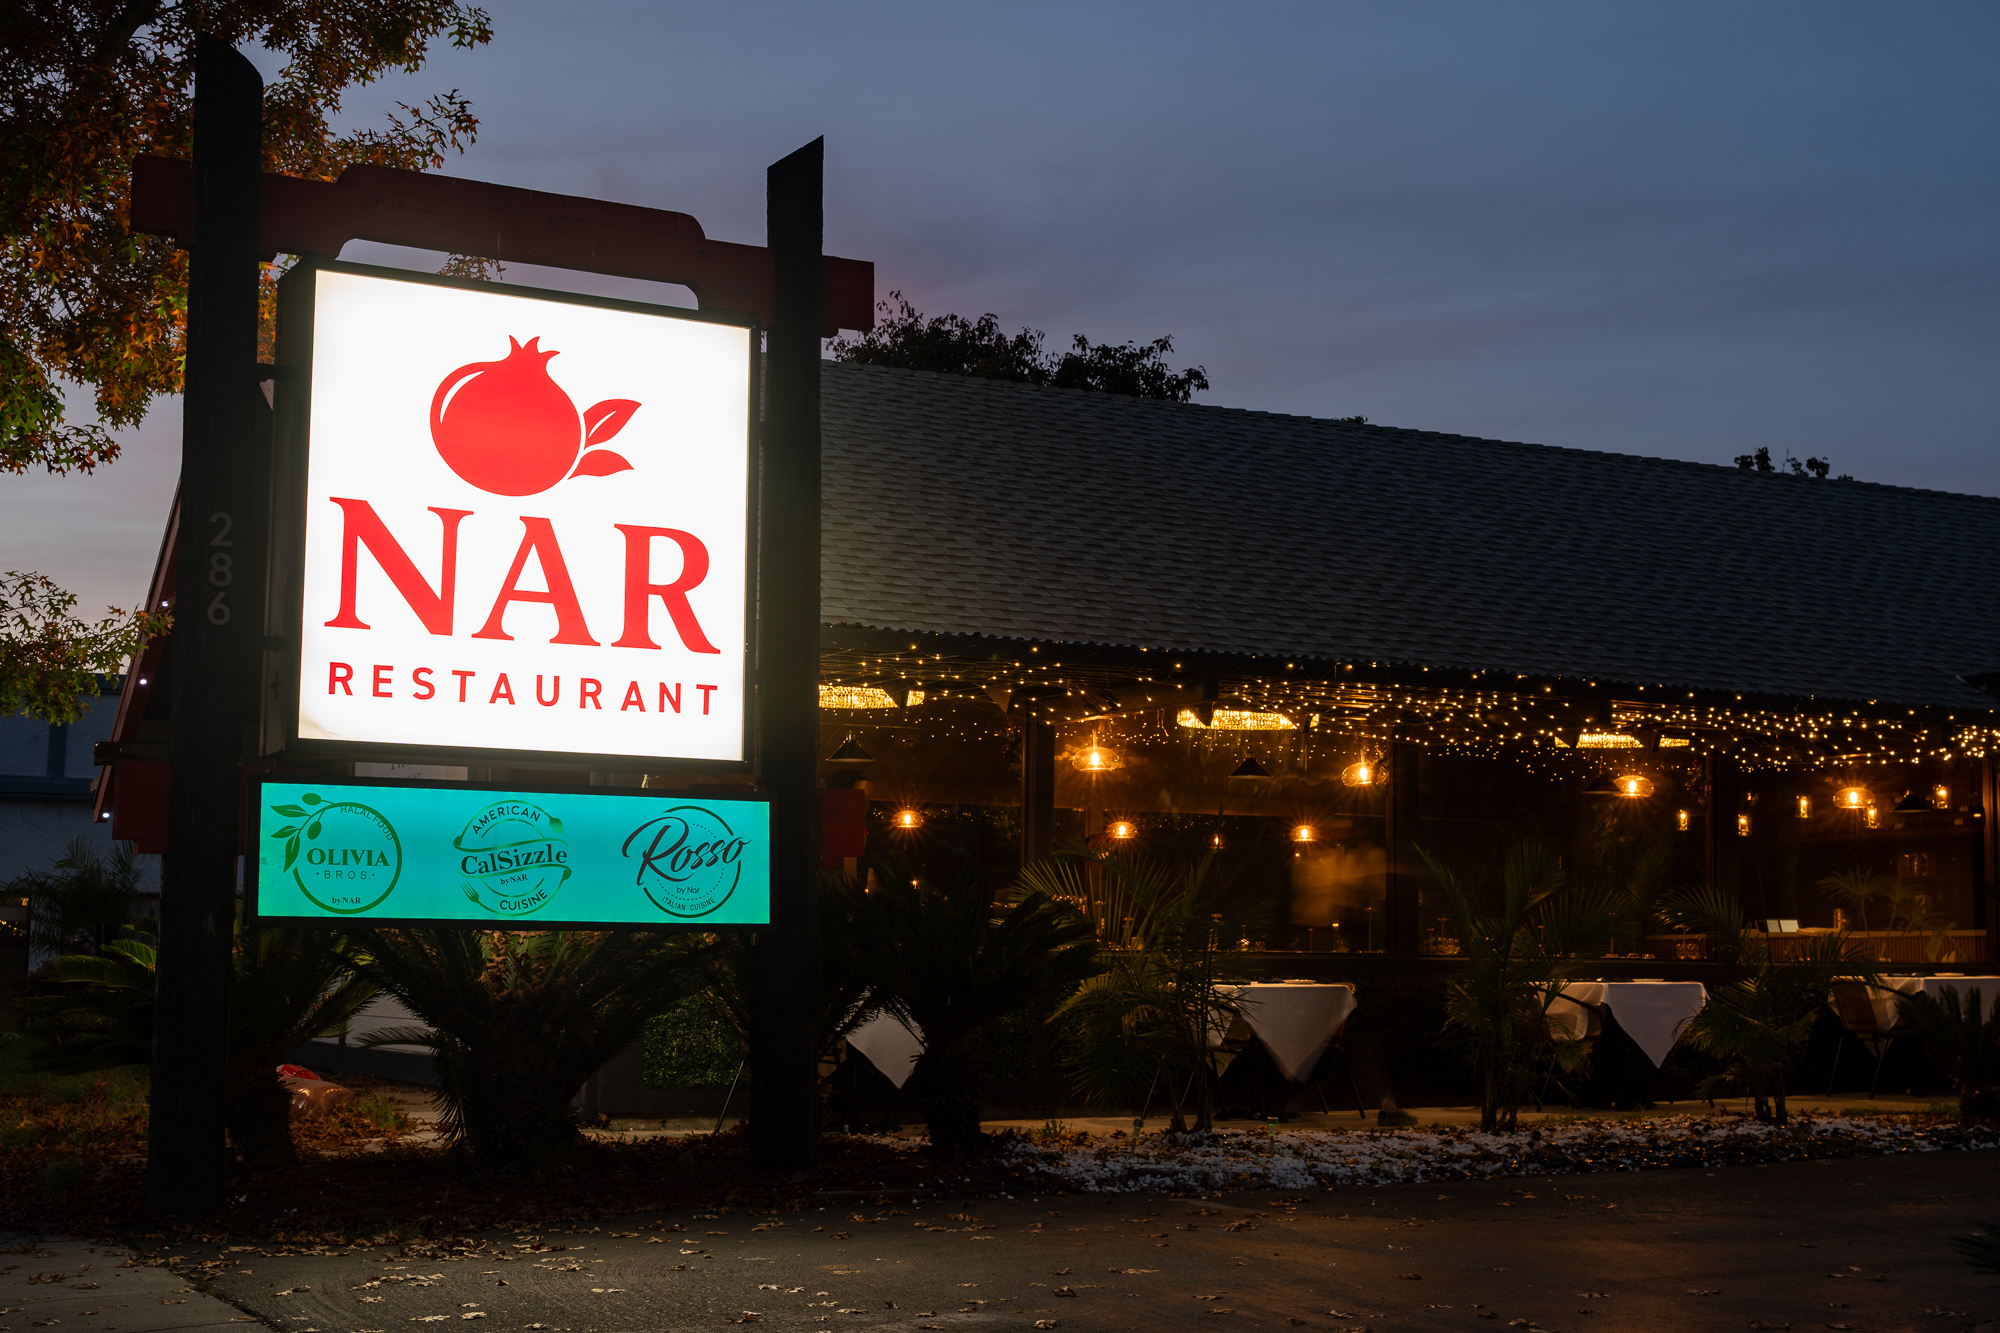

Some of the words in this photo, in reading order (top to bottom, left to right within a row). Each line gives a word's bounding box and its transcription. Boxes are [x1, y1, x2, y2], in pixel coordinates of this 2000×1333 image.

[207, 511, 233, 626] 286
[324, 496, 721, 655] NAR
[328, 662, 718, 715] RESTAURANT
[340, 805, 372, 820] HALAL
[372, 817, 393, 841] FOOD
[472, 805, 541, 834] AMERICAN
[306, 848, 391, 867] OLIVIA
[461, 843, 568, 875] CalSizzle
[621, 816, 752, 886] Rosso
[499, 888, 548, 911] CUISINE
[661, 896, 687, 912] ITALIAN
[689, 896, 716, 912] CUISINE
[676, 886, 686, 895] by
[687, 886, 700, 894] Nar
